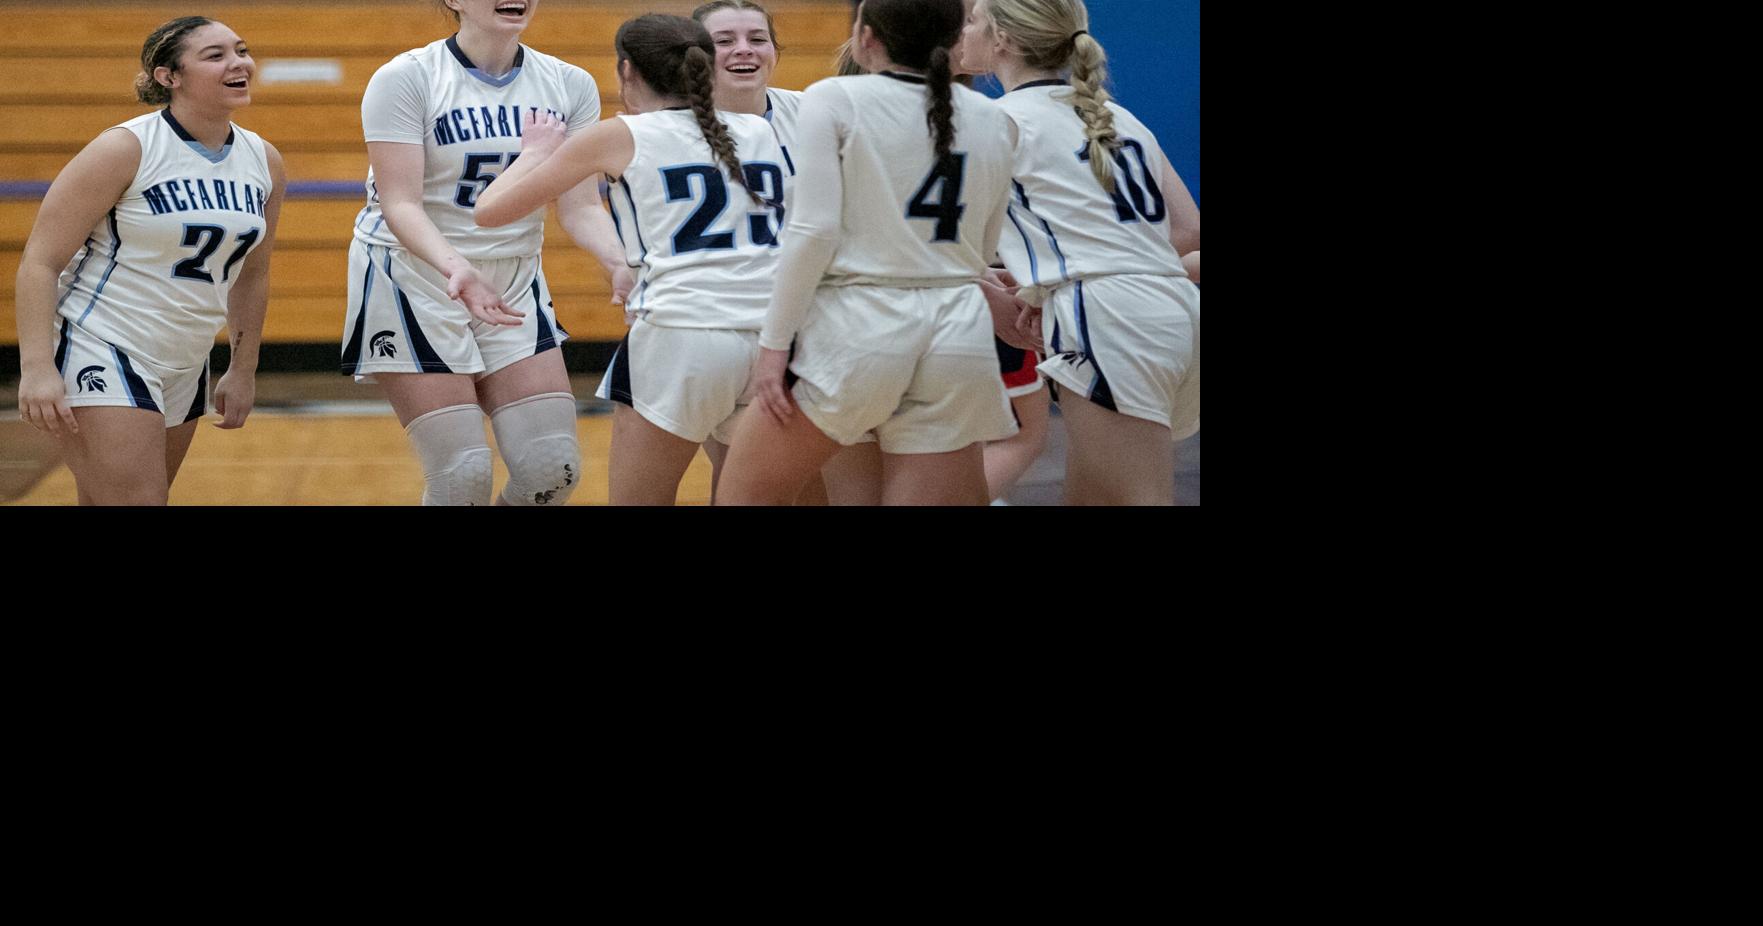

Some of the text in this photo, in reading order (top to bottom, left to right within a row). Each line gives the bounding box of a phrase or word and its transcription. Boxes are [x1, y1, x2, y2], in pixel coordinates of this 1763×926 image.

[433, 104, 565, 146] MCFARL
[453, 152, 521, 208] 5
[657, 161, 785, 256] 23
[904, 151, 967, 243] 4
[171, 222, 260, 284] 21
